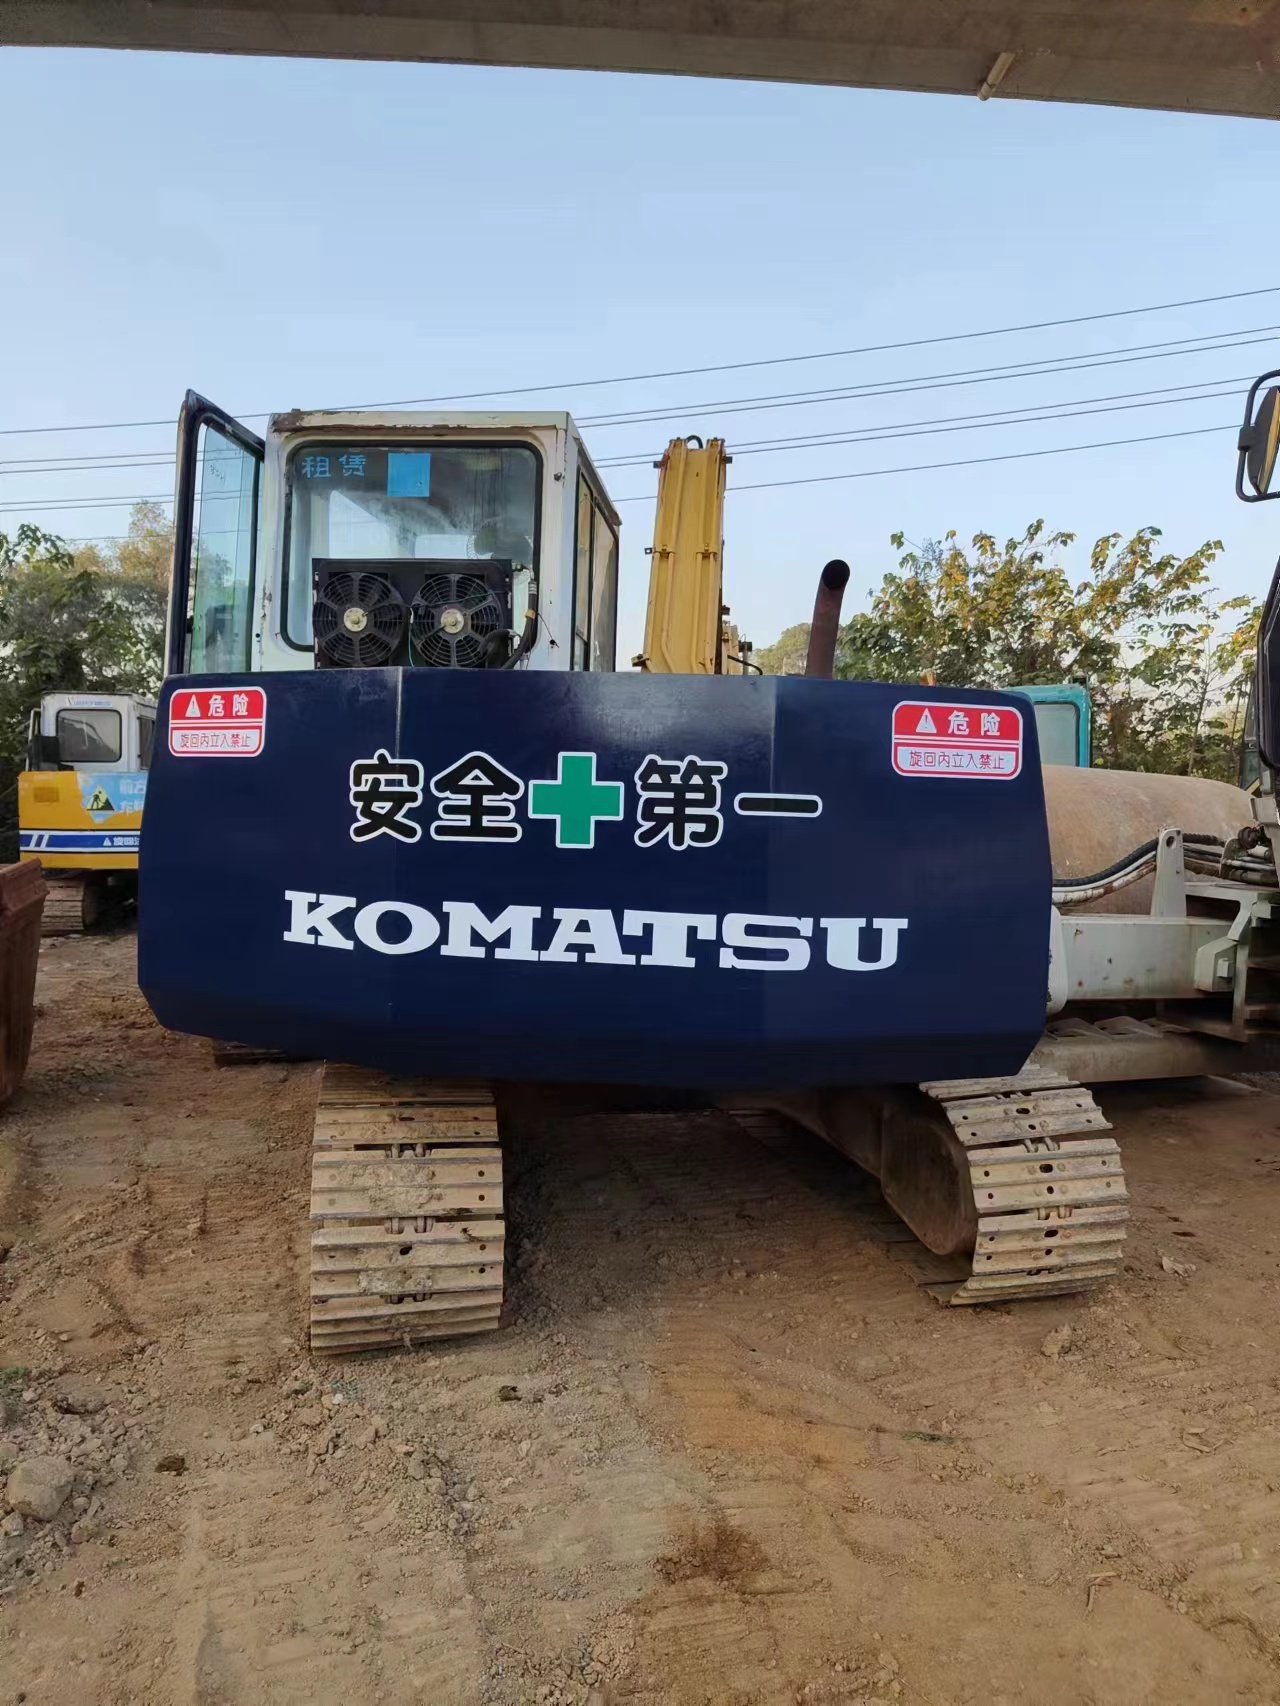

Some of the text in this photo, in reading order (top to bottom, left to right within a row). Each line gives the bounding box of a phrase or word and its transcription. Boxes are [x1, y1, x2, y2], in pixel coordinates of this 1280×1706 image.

[301, 454, 366, 478] 租赁
[349, 749, 823, 850] 安全 第一
[283, 890, 908, 971] KOMATSU
